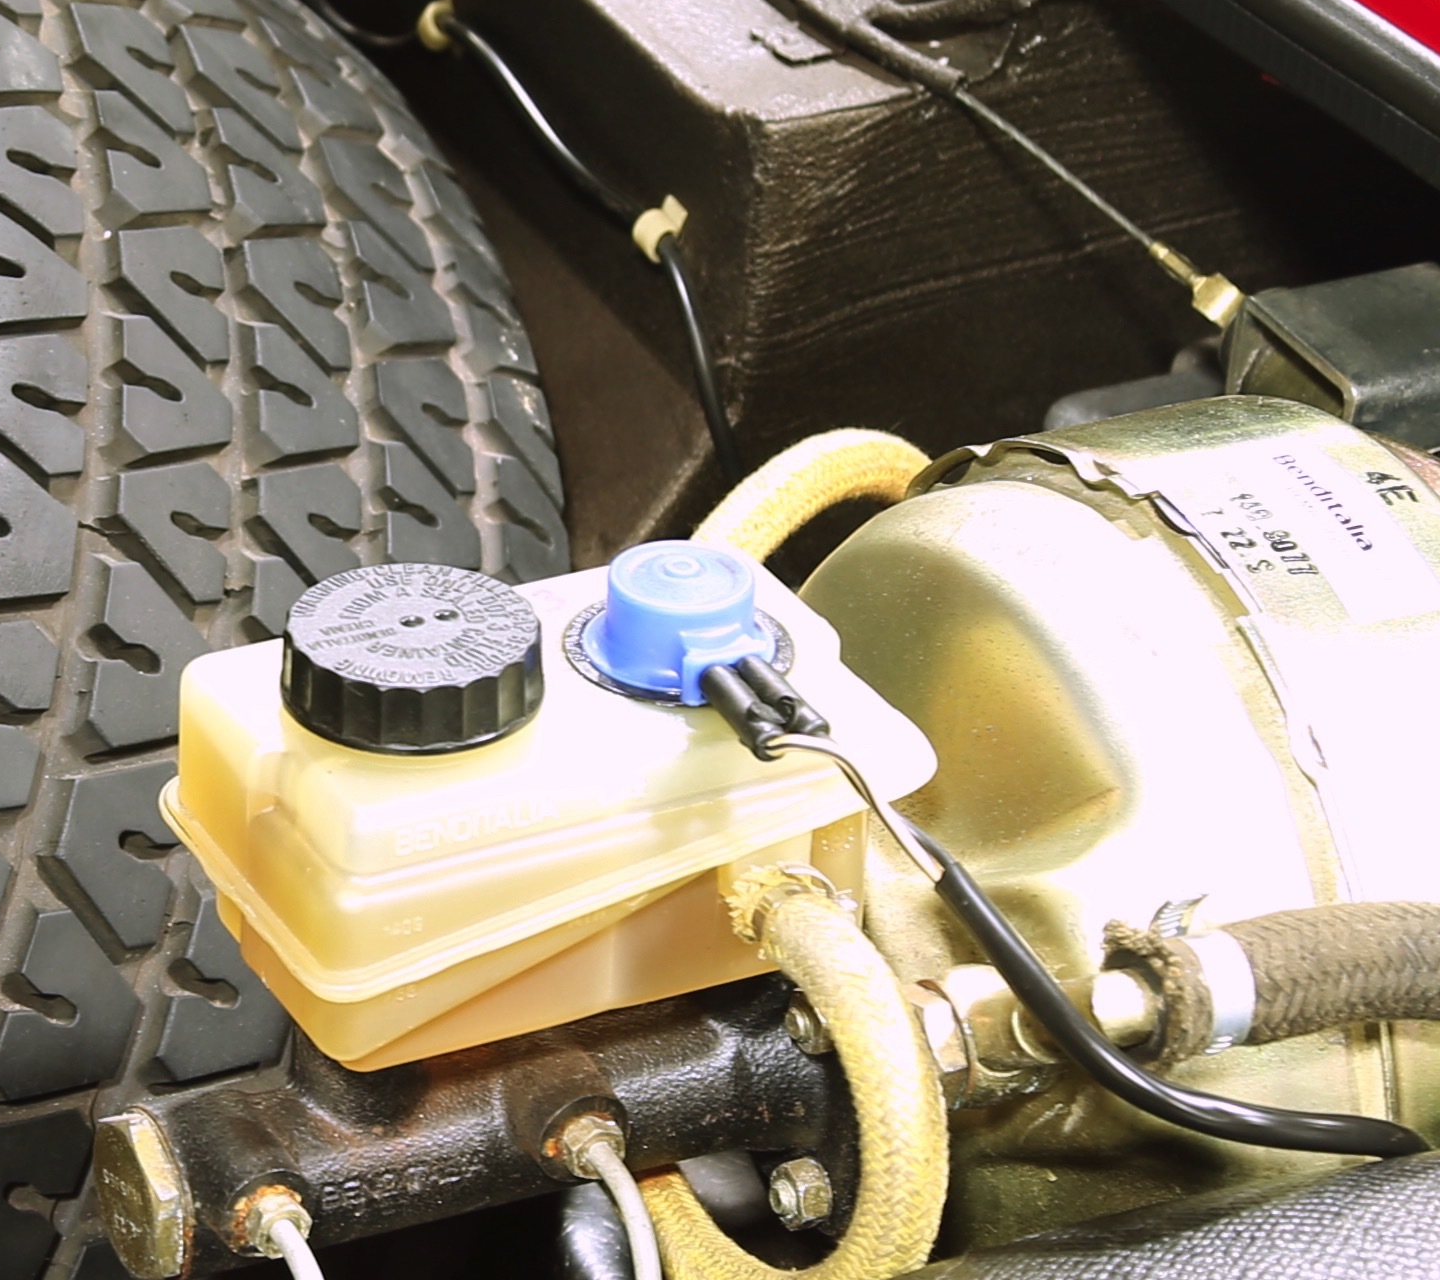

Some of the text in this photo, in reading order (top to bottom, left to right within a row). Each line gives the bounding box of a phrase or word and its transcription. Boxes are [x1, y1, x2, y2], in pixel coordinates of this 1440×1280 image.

[1272, 454, 1373, 551] Benditalia
[365, 575, 412, 588] USE
[370, 564, 453, 578] CLEAN
[423, 575, 482, 597] ONLY
[458, 571, 523, 606] FILLER
[338, 586, 487, 659] FROM A SEALED CONTAINER
[506, 608, 538, 632] CAP
[443, 637, 504, 668] FLUID
[332, 658, 458, 684] REMOVING
